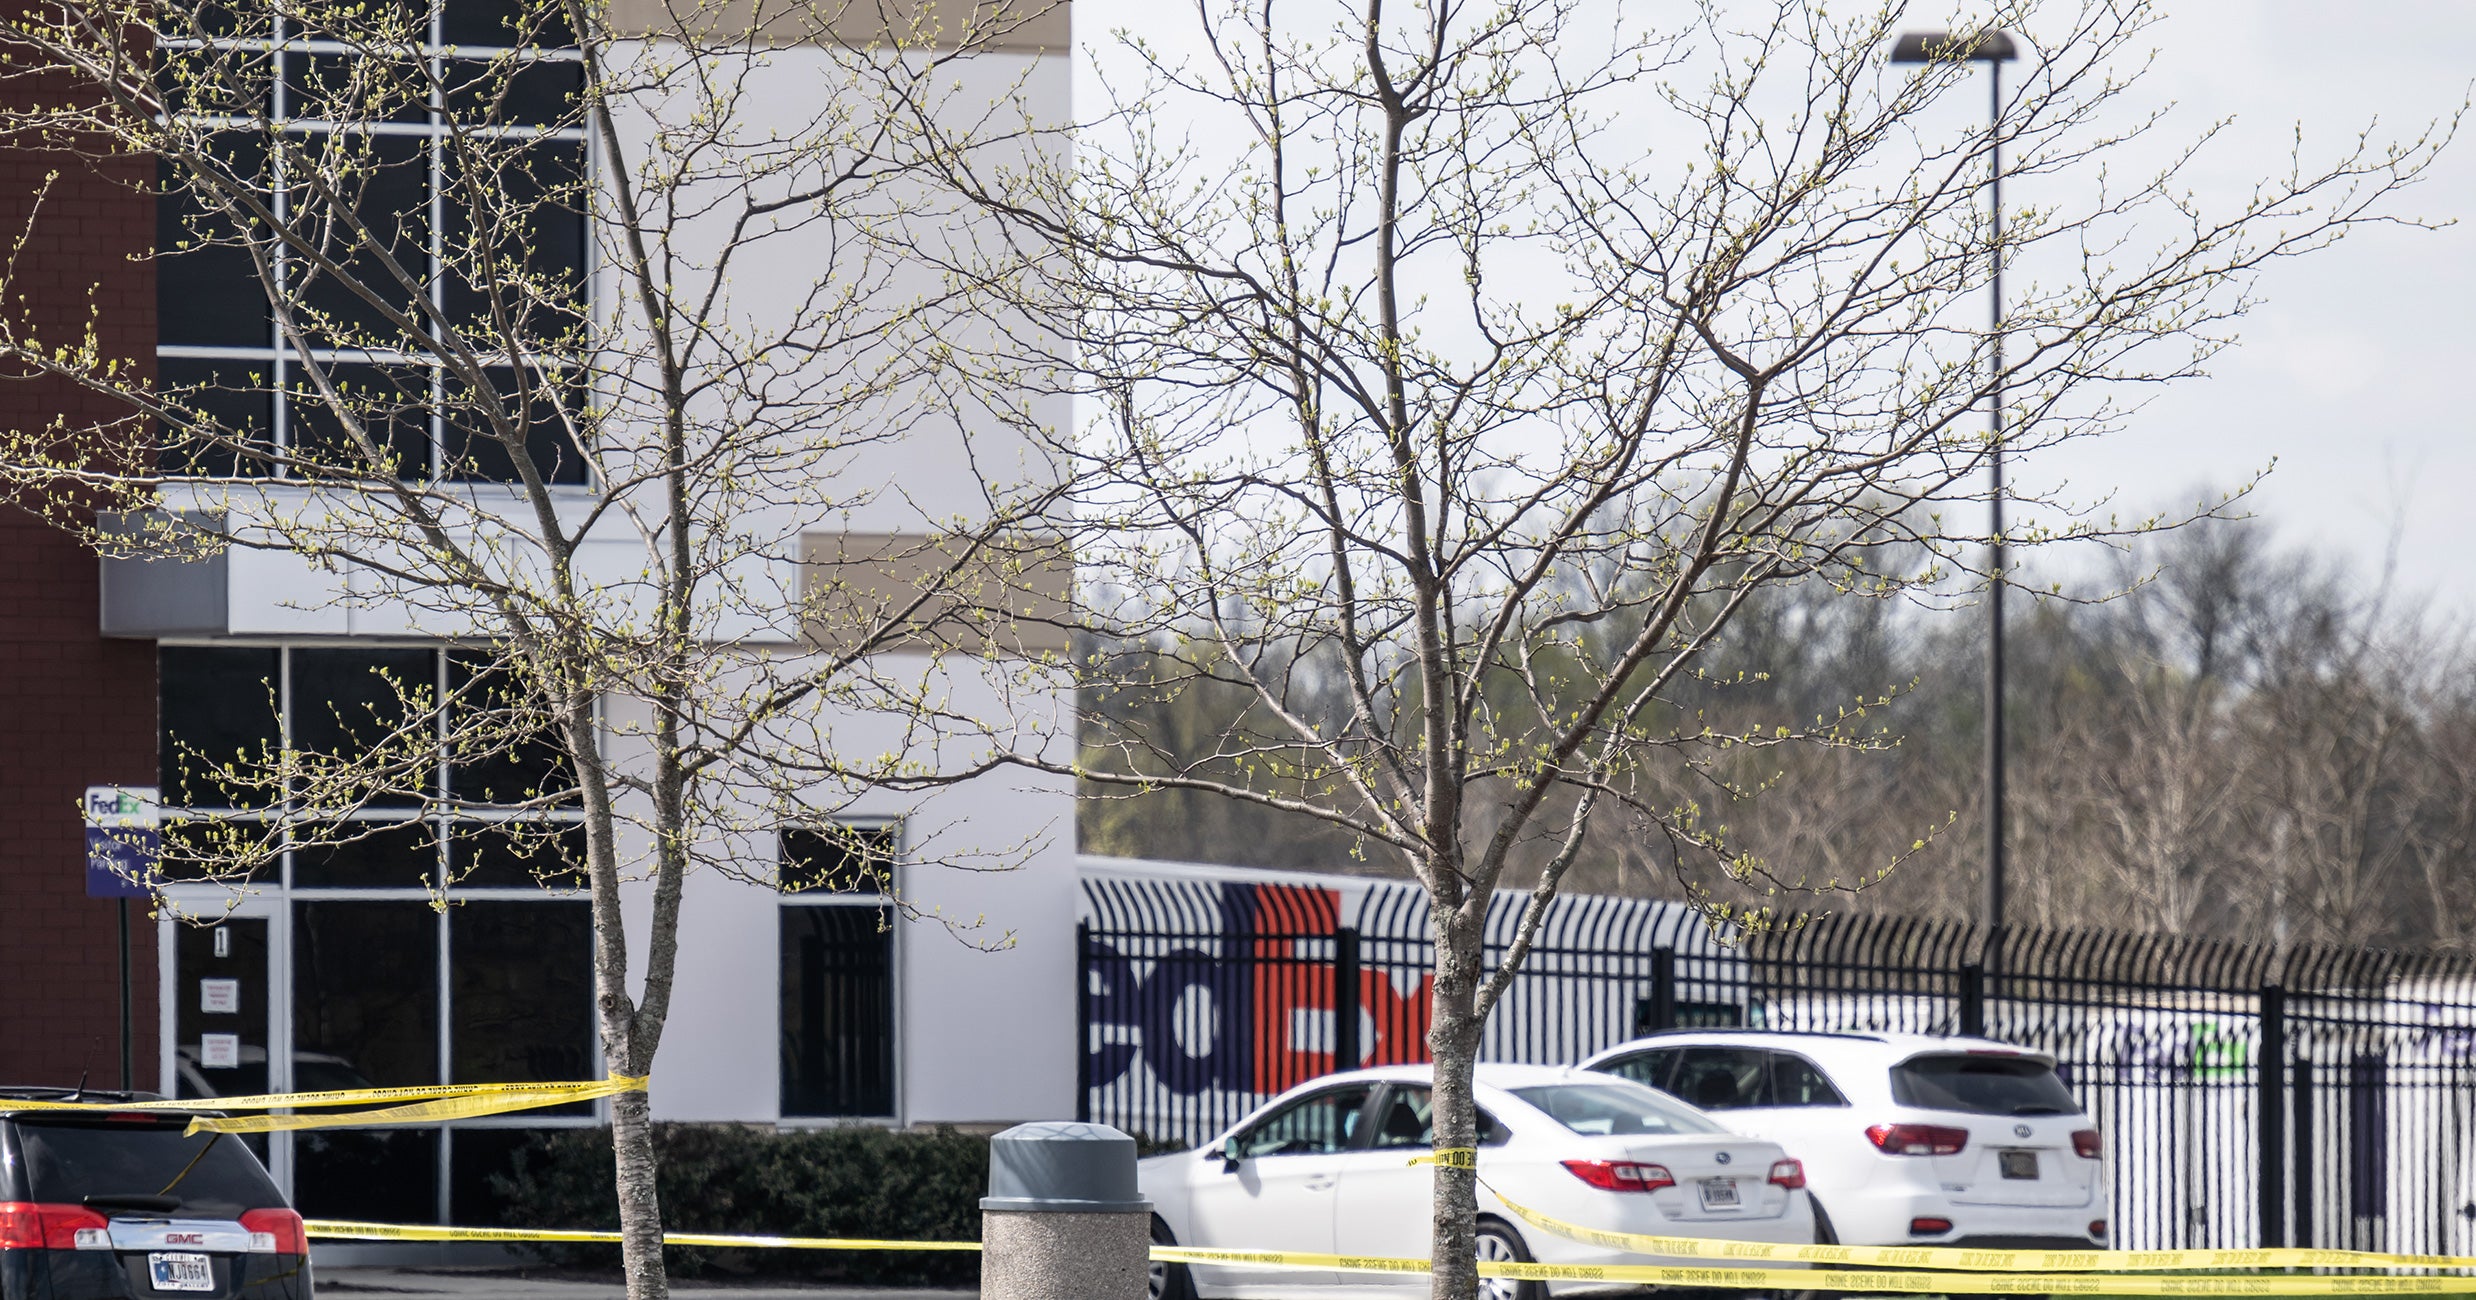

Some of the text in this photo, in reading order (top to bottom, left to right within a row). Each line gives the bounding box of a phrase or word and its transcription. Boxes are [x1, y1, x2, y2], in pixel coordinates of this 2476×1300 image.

[91, 794, 140, 815] FedEx
[89, 838, 122, 853] Vsitor
[1088, 883, 1434, 1095] edEx
[166, 1233, 203, 1245] GMC
